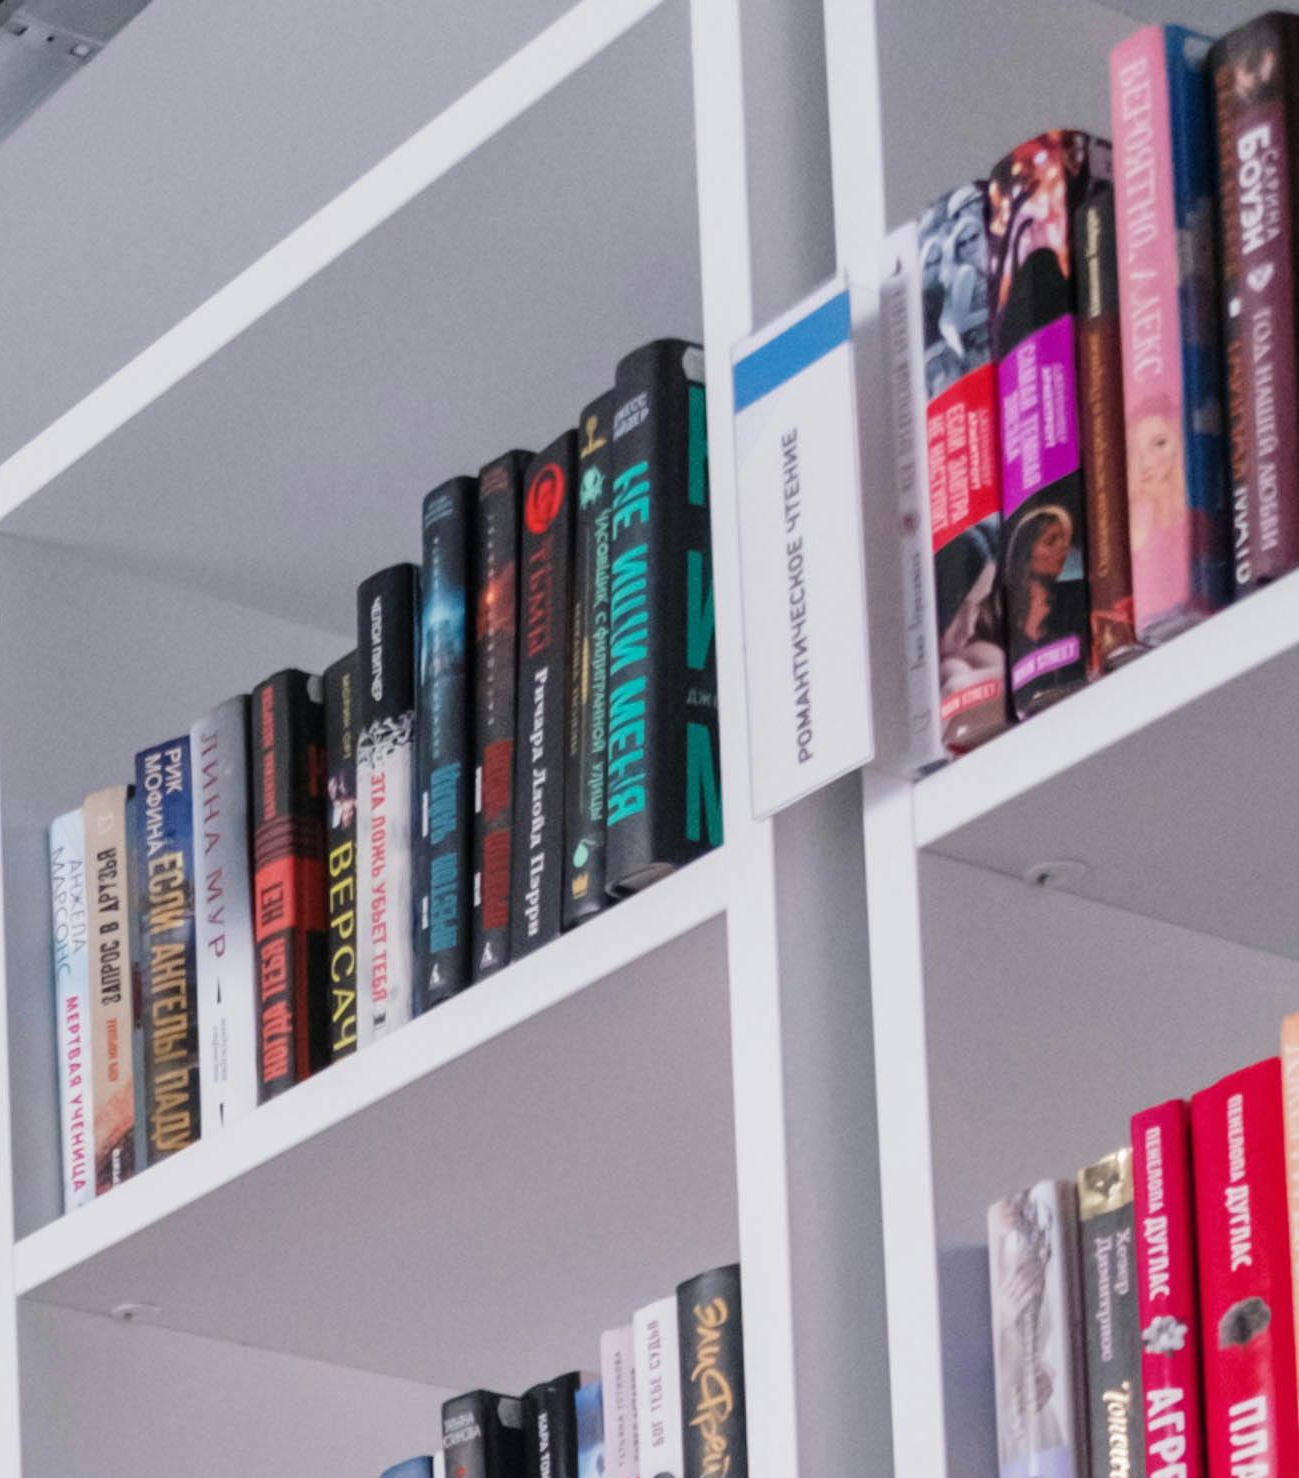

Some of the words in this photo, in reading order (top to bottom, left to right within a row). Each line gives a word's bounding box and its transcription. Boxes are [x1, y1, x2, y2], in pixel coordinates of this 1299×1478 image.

[1240, 127, 1274, 257] БОУЭН
[614, 463, 650, 540] НЕ
[780, 428, 800, 533] ЧТЕНИЕ
[610, 546, 649, 673] ИЩИ
[786, 536, 813, 764] РОМАНТИЧЕСКОЕ
[529, 668, 551, 764] Ричард
[607, 678, 647, 827] МЕНЯ
[143, 754, 164, 857] МОФИНА
[162, 748, 184, 794] РИК
[200, 732, 222, 853] ЛИНА
[372, 774, 389, 810] ЭТА
[97, 848, 119, 911] ДРУЗЬЯ
[147, 852, 185, 931] ЕСЛИ
[372, 816, 389, 880] ЛОЖЬ
[68, 858, 88, 954] АНЖЕЛА
[205, 867, 227, 960] МУР
[262, 885, 286, 927] НЕТ
[372, 887, 389, 946] УБЬЕТ
[523, 855, 546, 938] Пэрри
[100, 943, 121, 1006] ЗАПРОС
[150, 943, 189, 1065] АНГЕЛЫ
[262, 942, 288, 998] ТЕБЯ
[372, 953, 389, 1002] ТЕБЯ
[64, 993, 85, 1086] МЕРТВАЯ
[68, 1093, 89, 1191] УЧЕНИЦА
[1143, 1126, 1163, 1213] ПЕНЕЛОПА
[1142, 1216, 1171, 1301] ДУГЛАС
[1224, 1184, 1252, 1272] ДУГЛАС
[538, 1413, 551, 1451] КАРА
